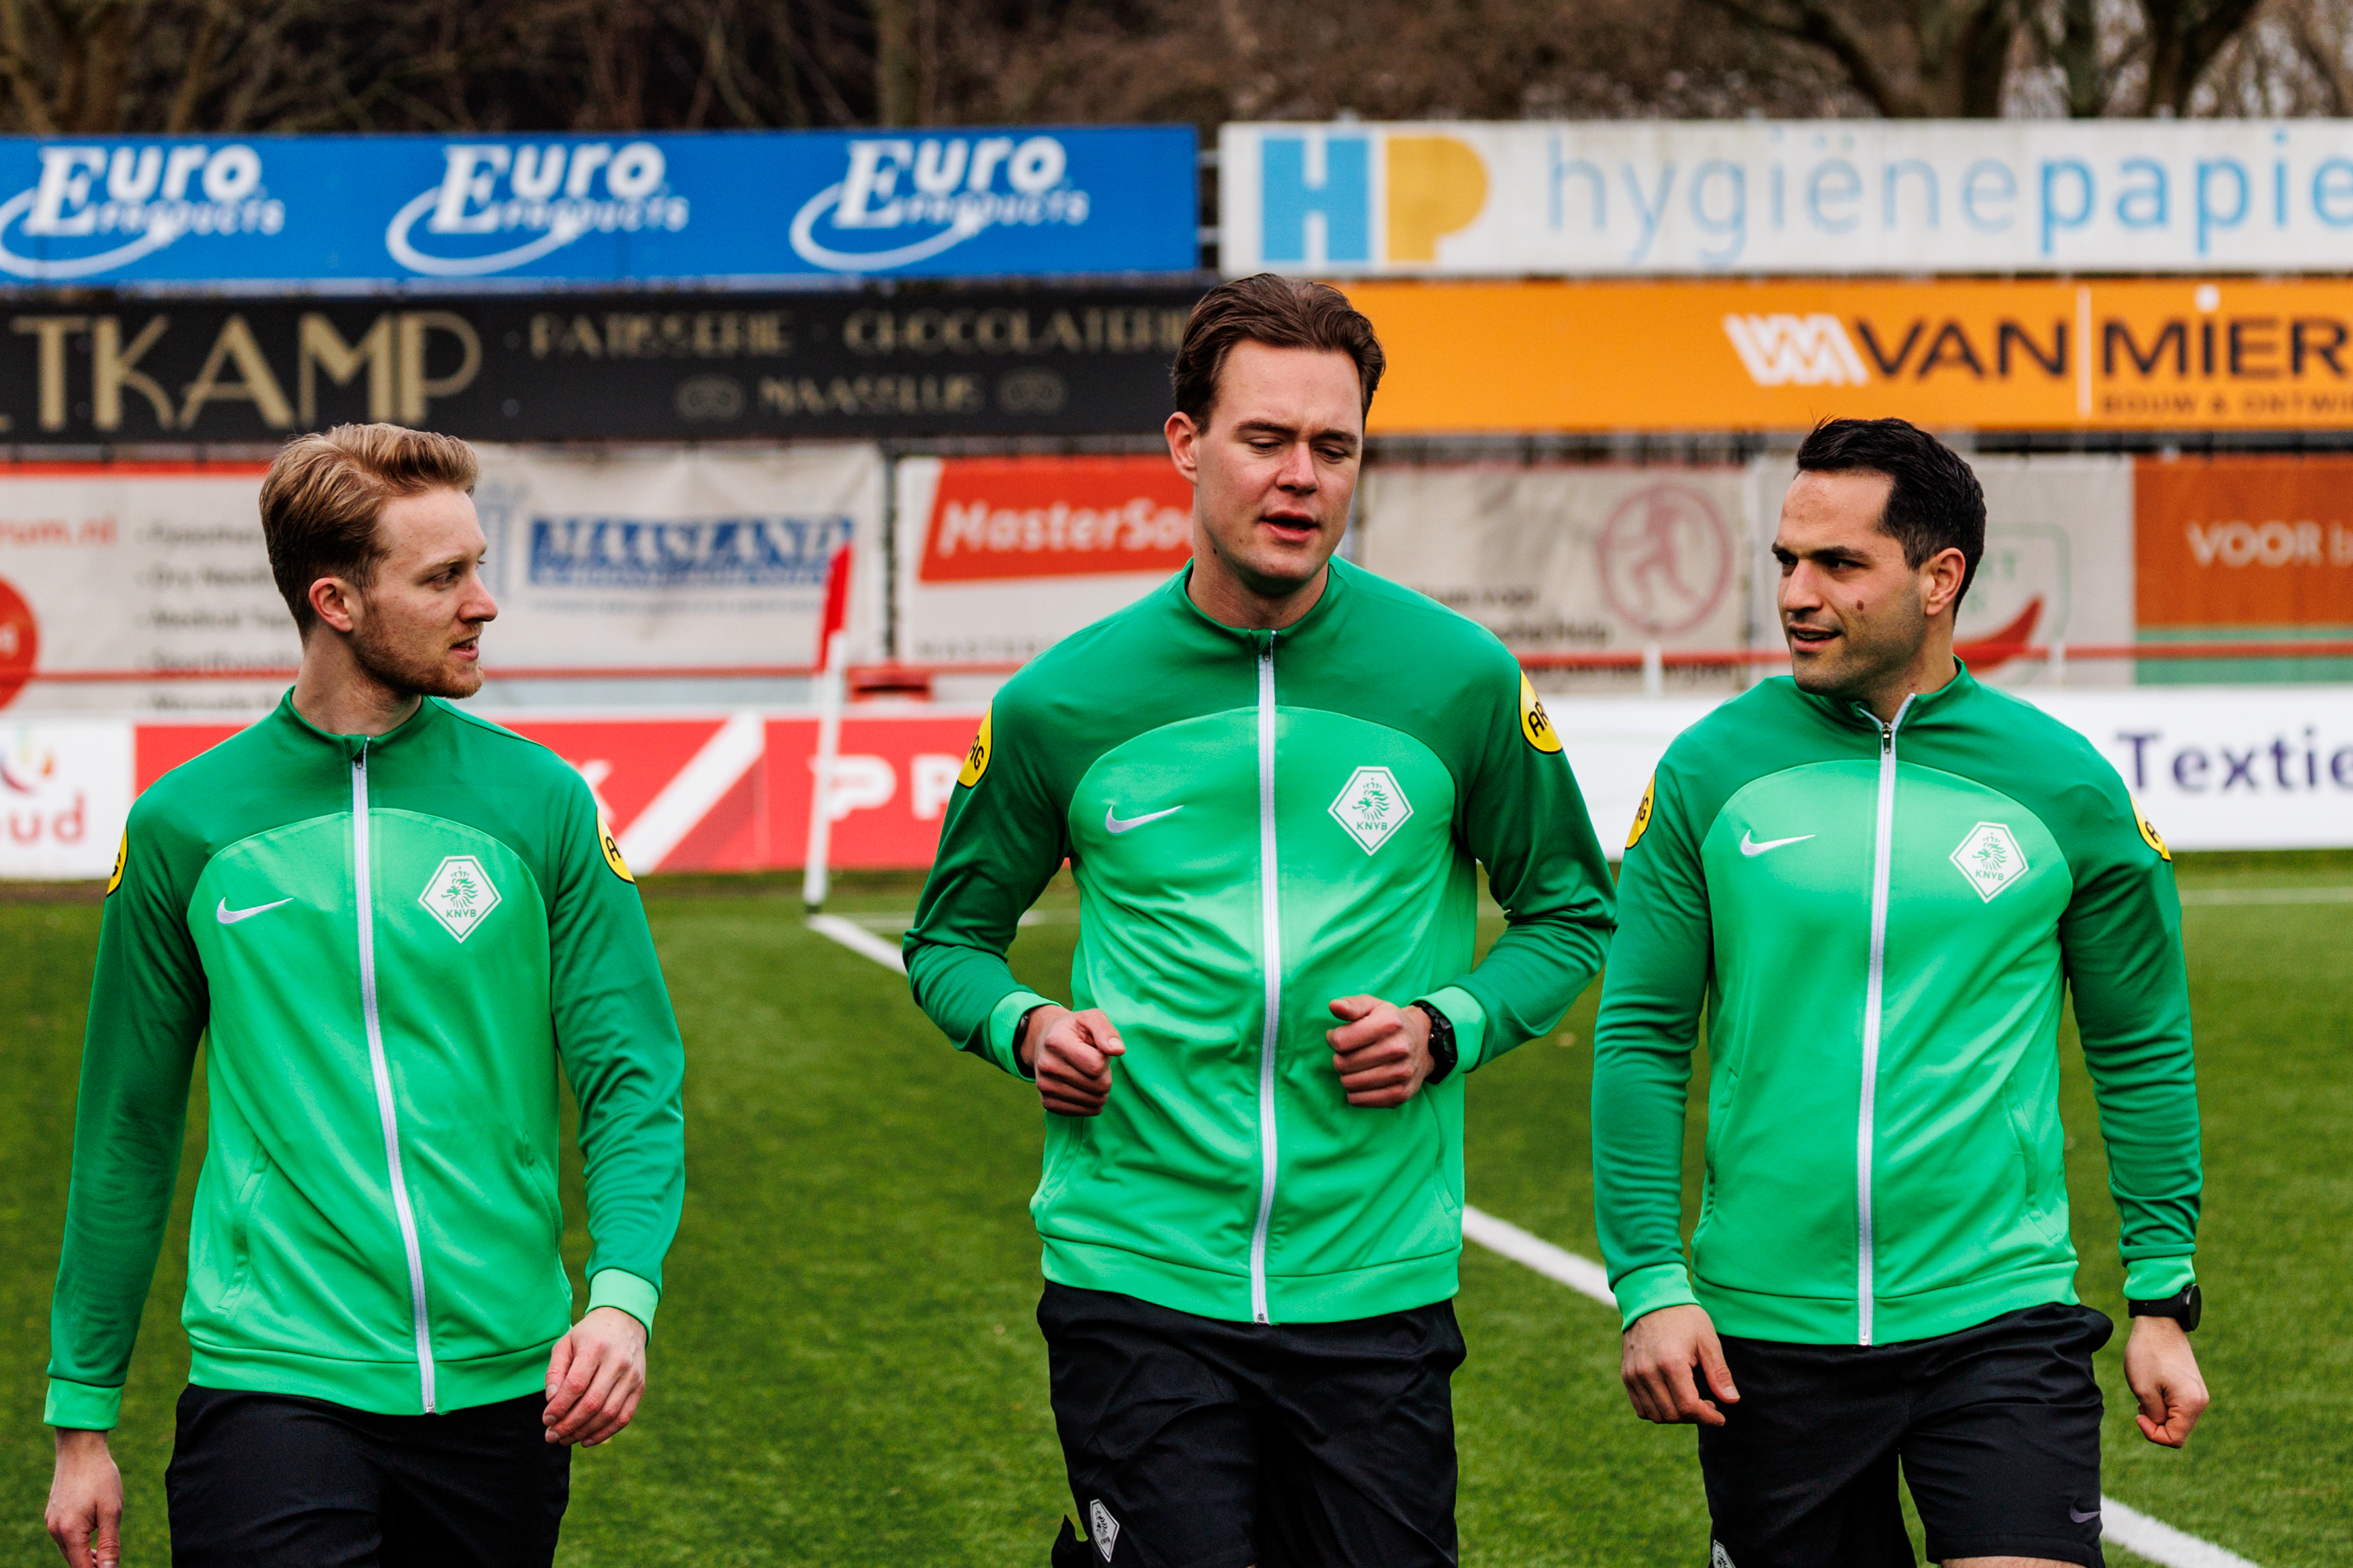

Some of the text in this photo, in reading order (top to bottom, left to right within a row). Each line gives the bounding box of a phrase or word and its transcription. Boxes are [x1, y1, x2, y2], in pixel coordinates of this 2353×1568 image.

[1260, 134, 1489, 263] HP
[0, 311, 481, 429] TKAMP
[1855, 317, 2069, 379] VAN
[936, 497, 1193, 558] MasterSo
[2186, 519, 2322, 569] VOOR
[0, 788, 86, 846] ud
[1356, 821, 1388, 830] KNVB
[1975, 869, 2004, 881] KNVB
[446, 909, 476, 918] KNVB
